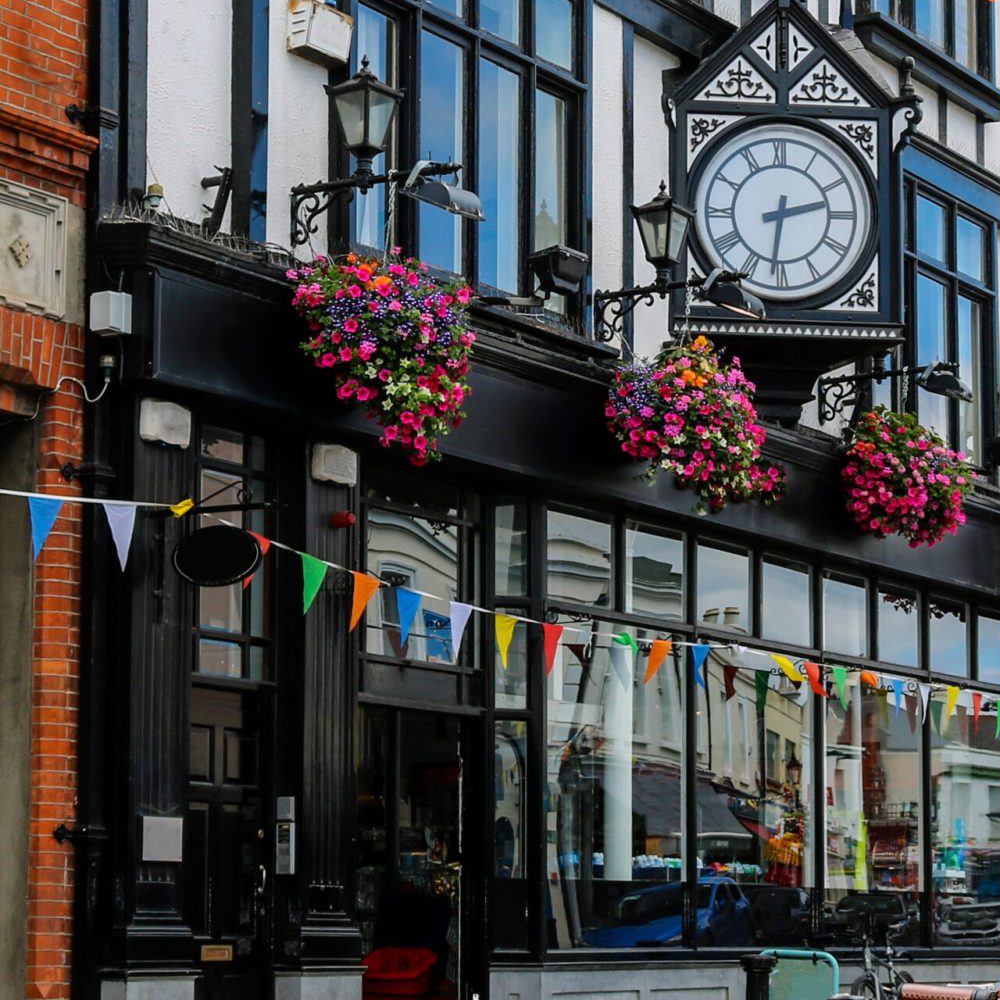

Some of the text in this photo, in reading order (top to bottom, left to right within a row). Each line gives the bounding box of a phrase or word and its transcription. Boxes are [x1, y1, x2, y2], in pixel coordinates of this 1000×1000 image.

[739, 147, 760, 174] XI
[773, 141, 787, 166] XII
[804, 151, 819, 173] I
[714, 171, 741, 191] X
[822, 177, 847, 193] II
[707, 205, 734, 218] IX
[829, 210, 856, 221] III
[713, 230, 741, 256] VIII
[804, 257, 822, 281] V
